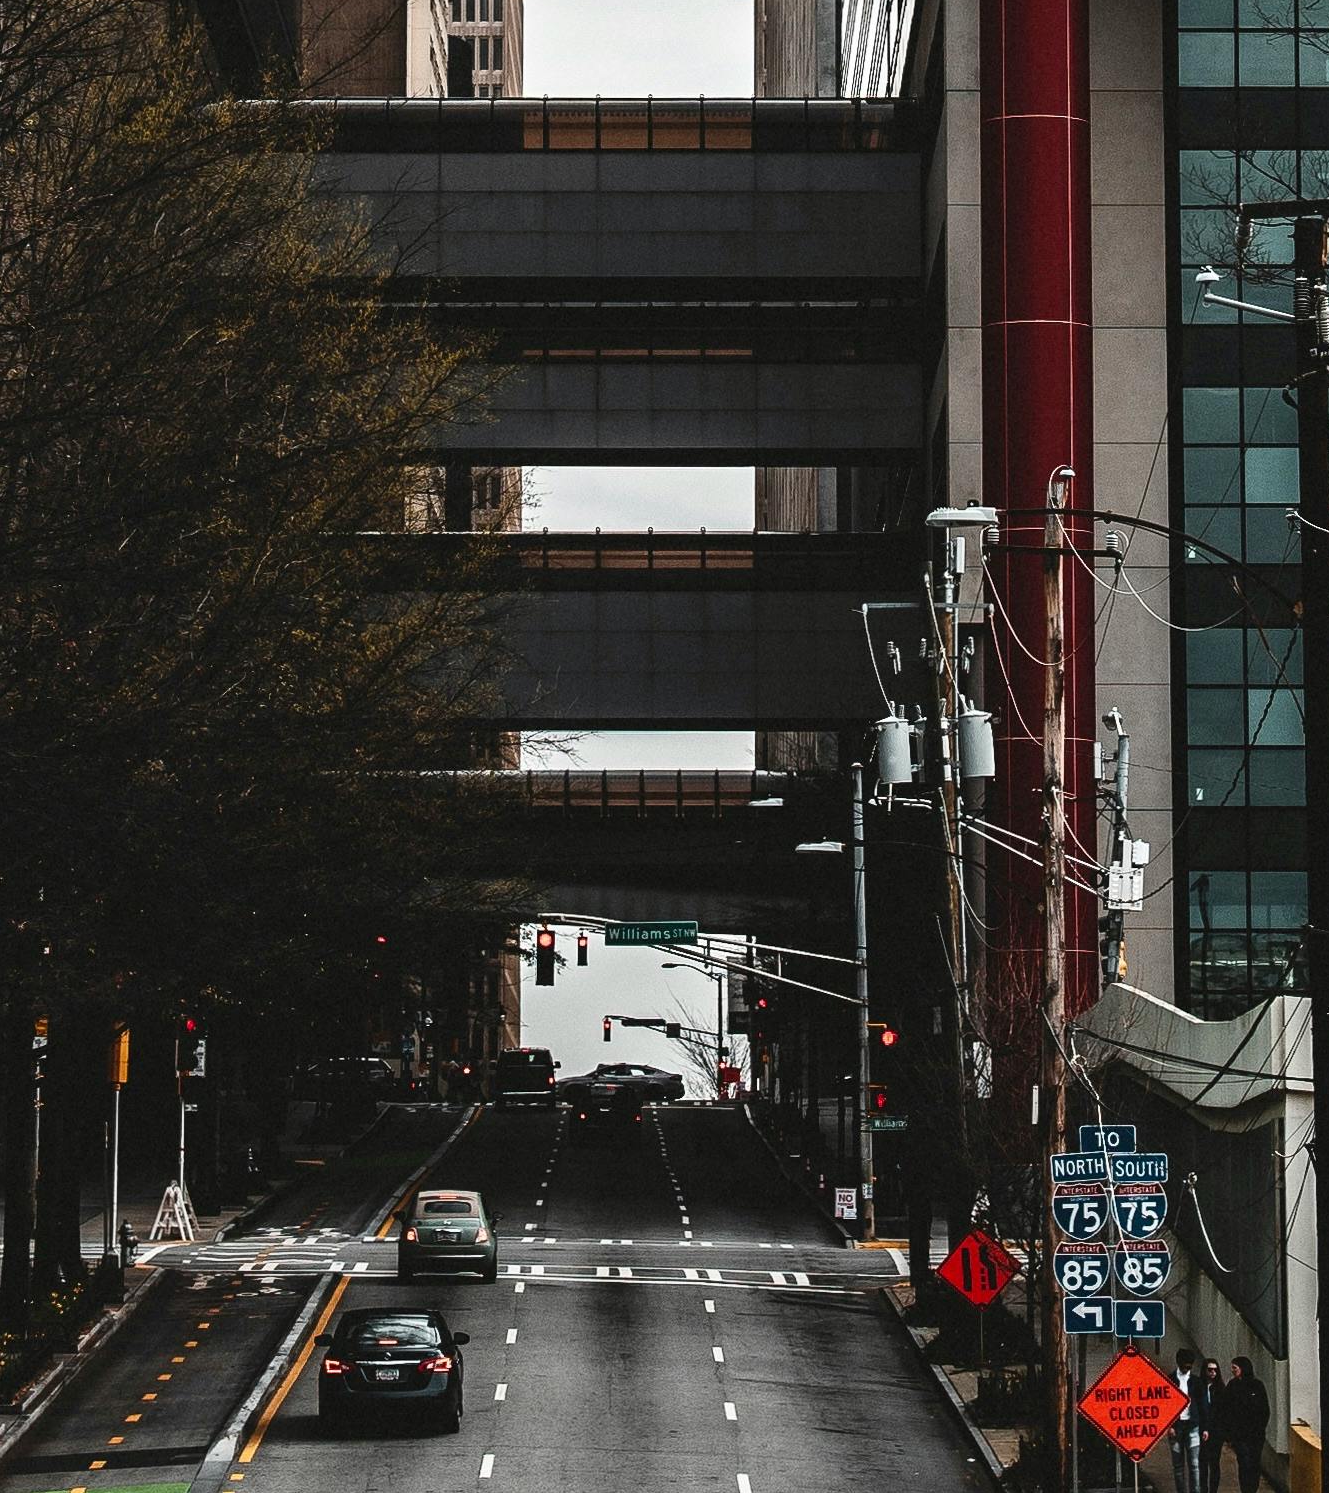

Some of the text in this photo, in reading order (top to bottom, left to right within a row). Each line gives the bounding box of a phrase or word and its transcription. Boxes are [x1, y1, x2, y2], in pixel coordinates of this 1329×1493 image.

[609, 928, 696, 939] Williams ST NW
[1094, 1131, 1120, 1147] TO
[1055, 1158, 1104, 1177] NORTH
[1115, 1160, 1165, 1177] SOUTH
[838, 1194, 853, 1203] NO
[1061, 1186, 1098, 1194] INTERSTATE
[1062, 1202, 1101, 1233] 75
[1120, 1202, 1159, 1232] 75
[1062, 1260, 1102, 1291] 85
[1123, 1258, 1163, 1289] 85
[1094, 1385, 1172, 1402] RIGHT LANE
[1109, 1405, 1160, 1421] CLOSED
[1116, 1424, 1158, 1438] AHEAD
